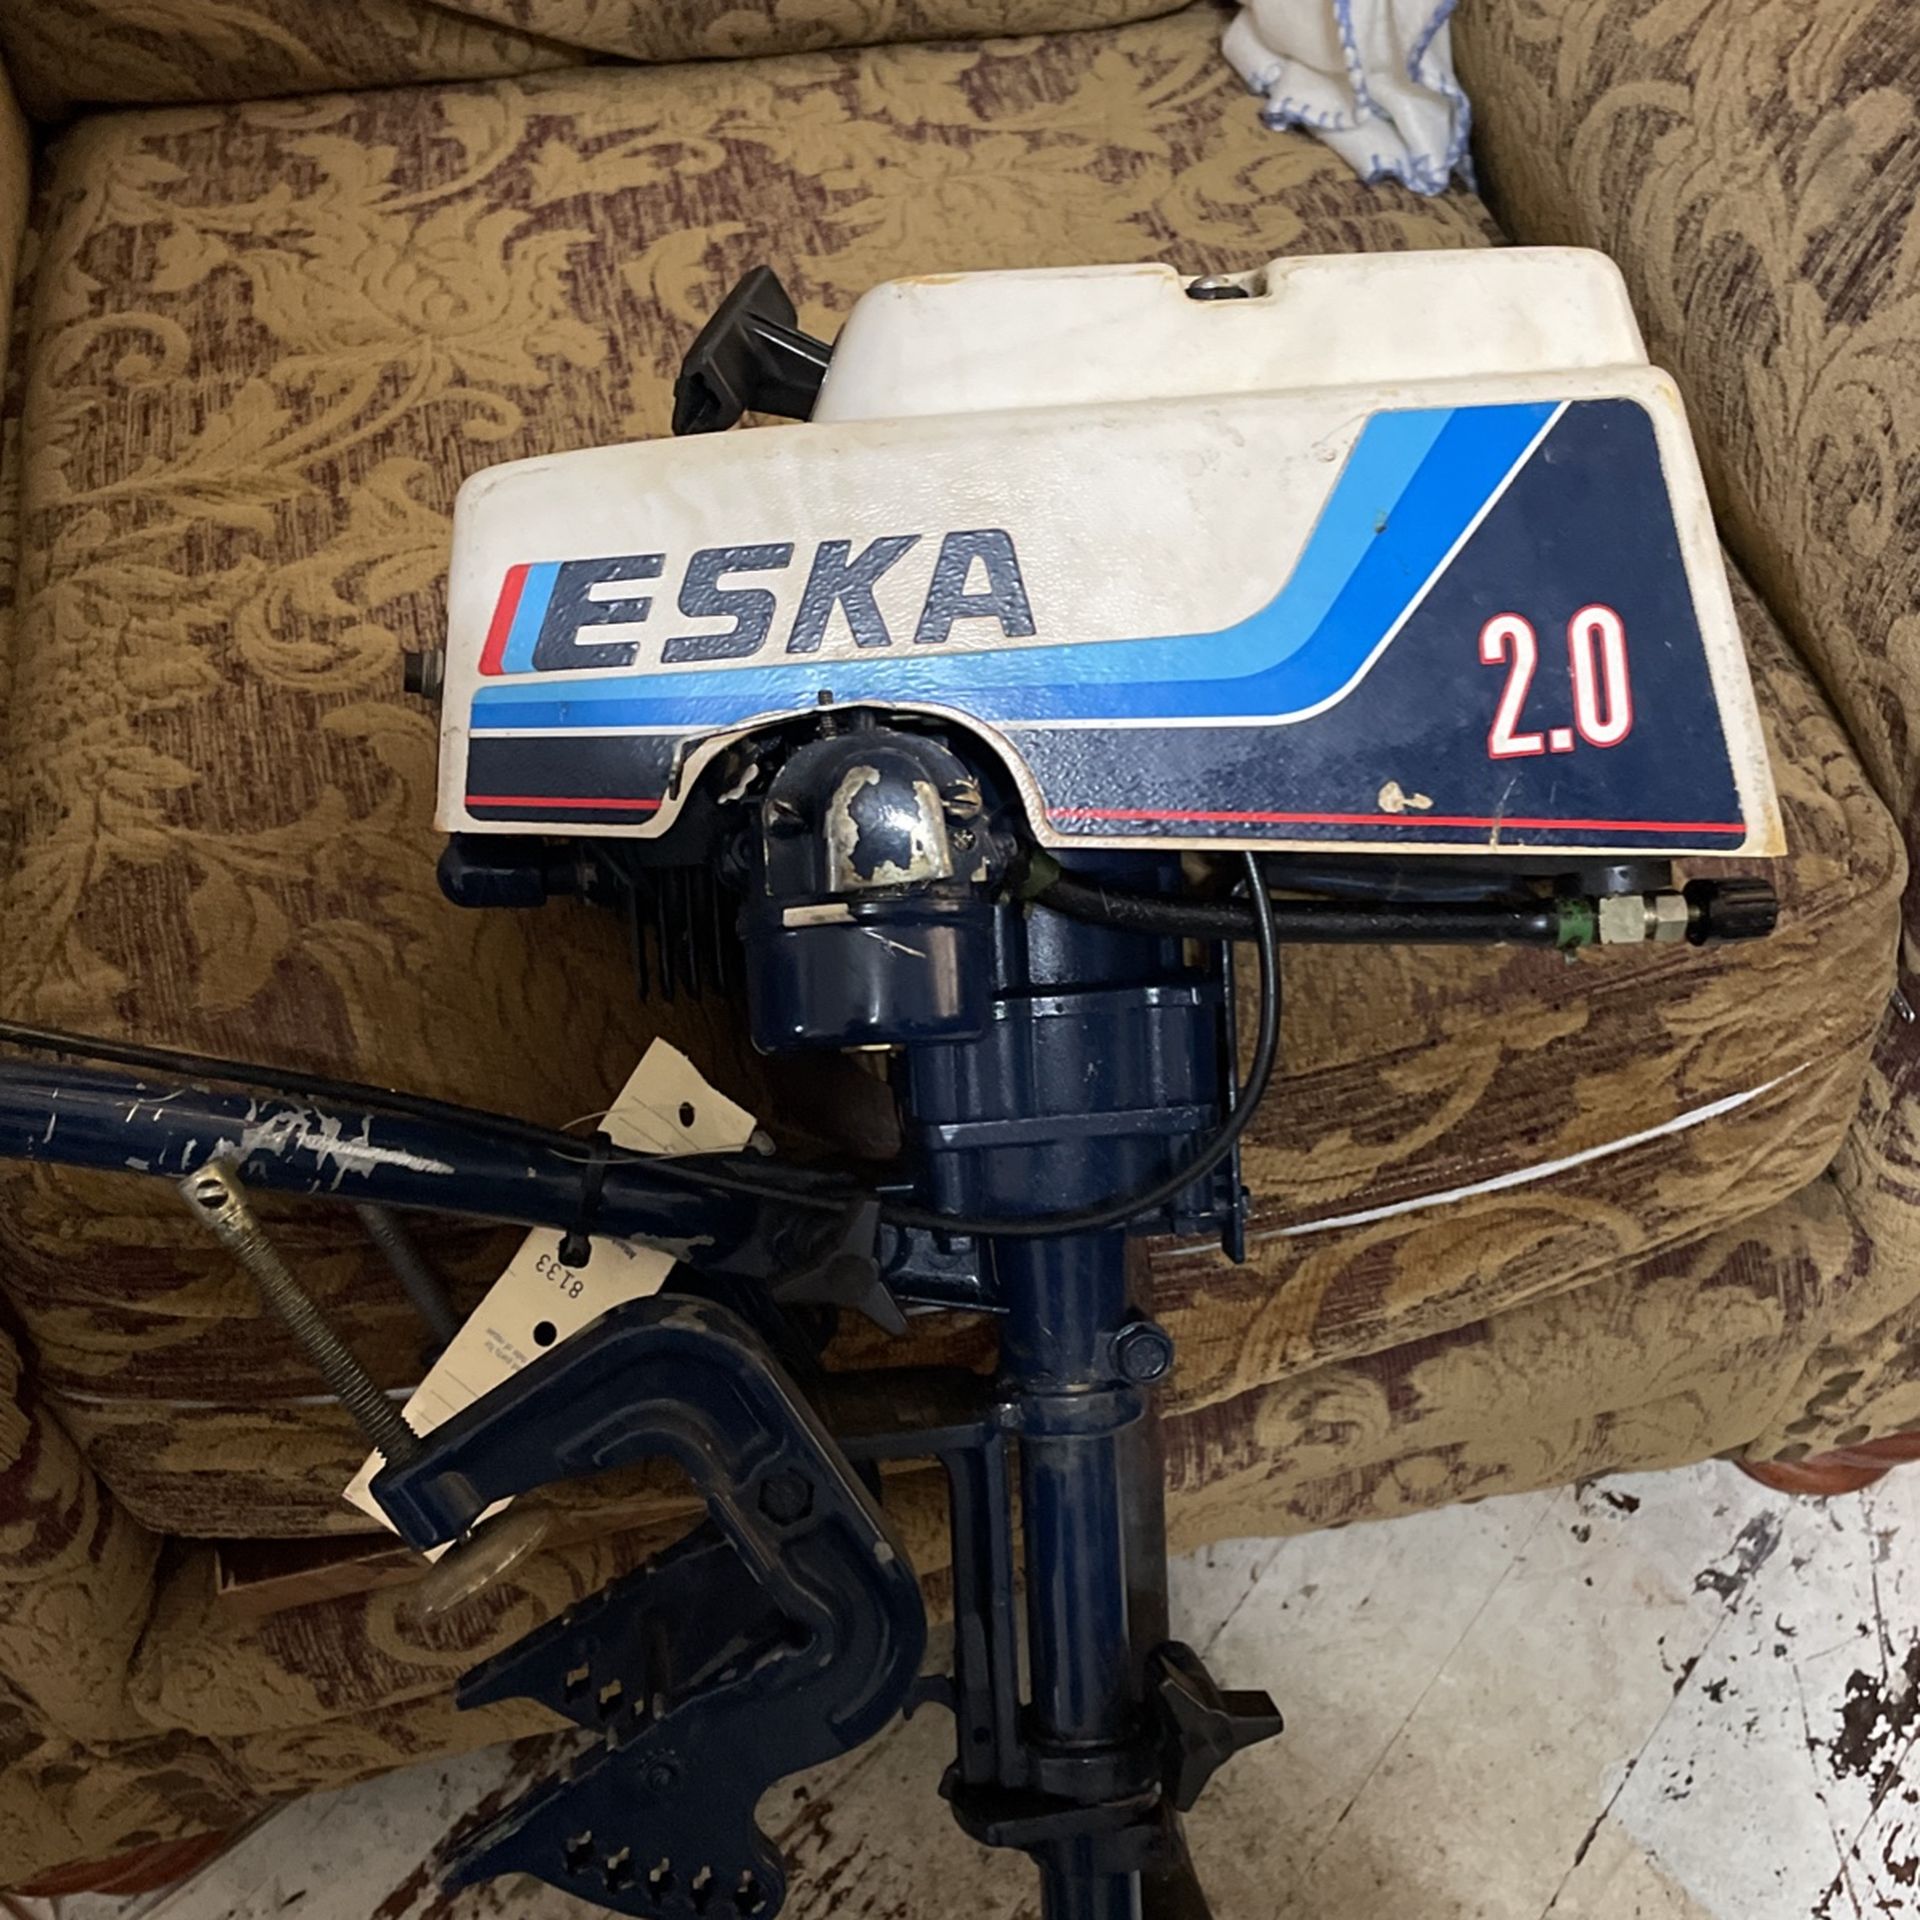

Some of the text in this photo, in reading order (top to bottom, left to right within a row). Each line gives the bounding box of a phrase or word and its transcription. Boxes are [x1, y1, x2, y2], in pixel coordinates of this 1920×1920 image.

[532, 529, 1036, 671] ESKA
[1479, 603, 1633, 759] 2.0
[535, 1253, 584, 1299] 8133
